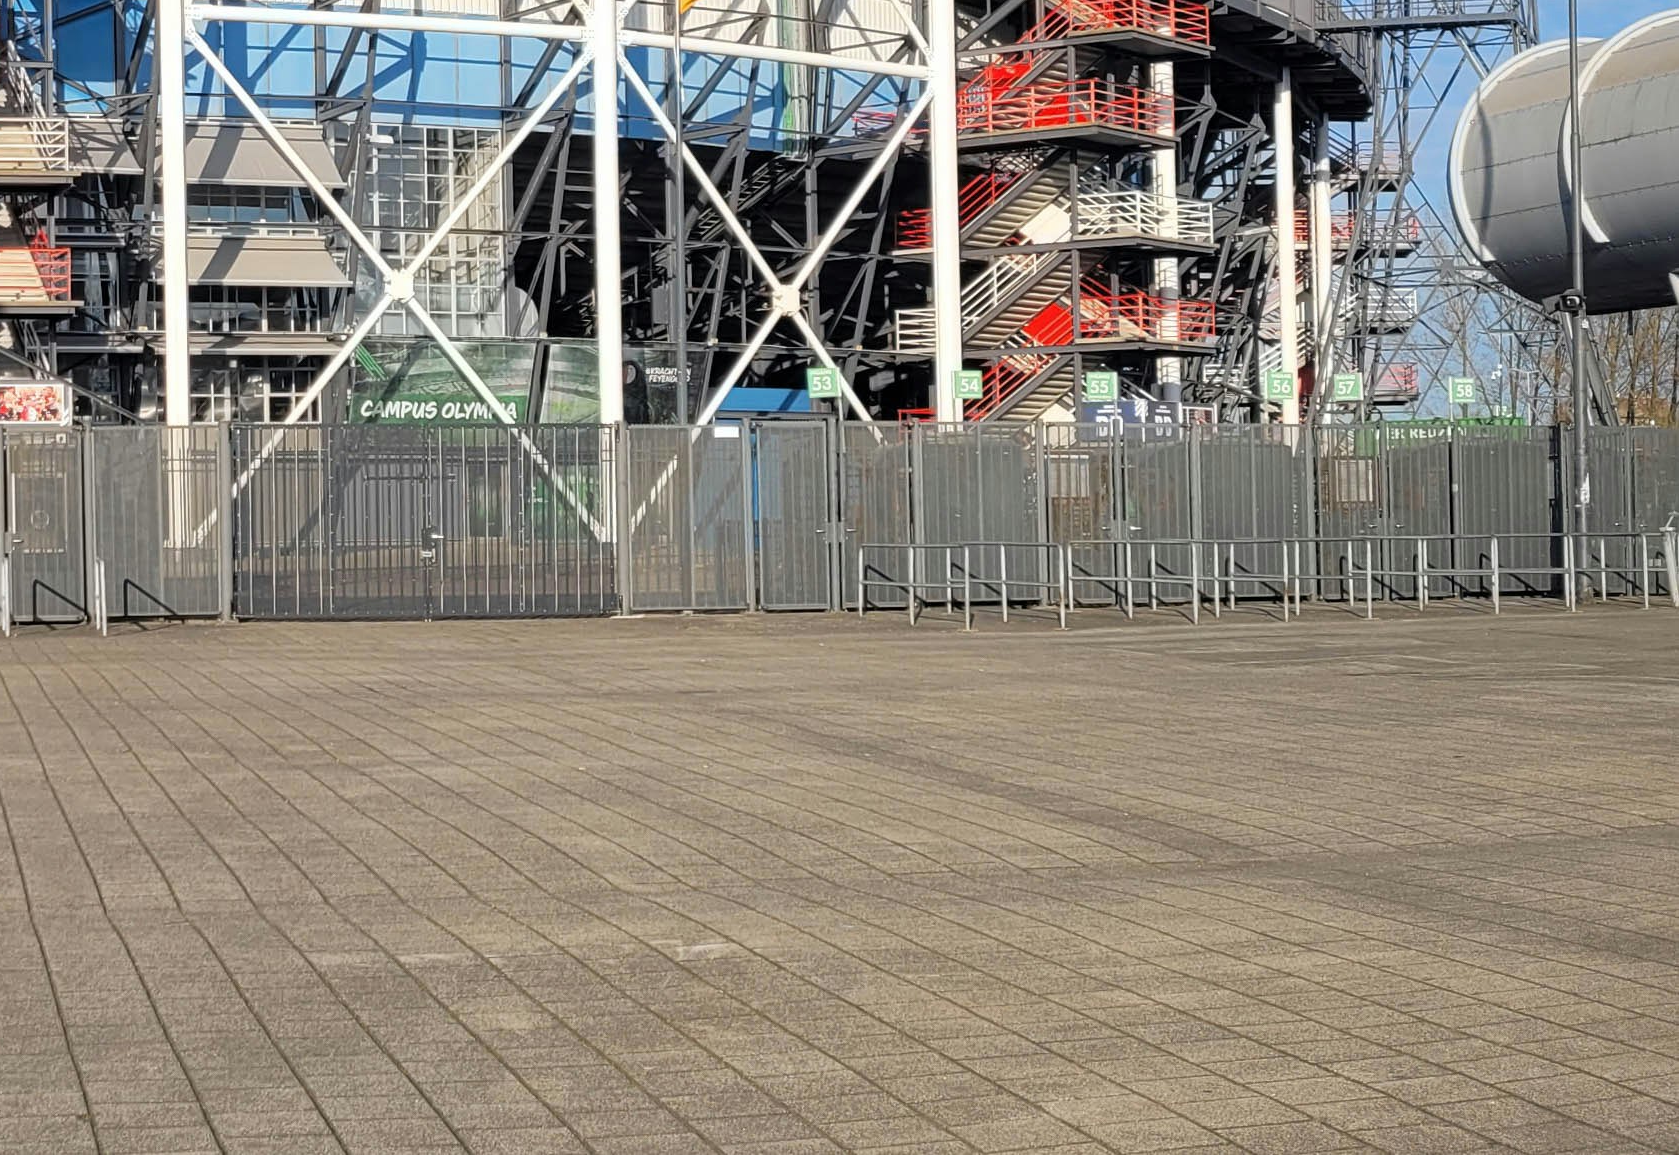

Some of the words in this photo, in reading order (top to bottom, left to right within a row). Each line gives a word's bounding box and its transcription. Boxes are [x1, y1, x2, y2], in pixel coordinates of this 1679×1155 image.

[813, 376, 832, 391] 53
[960, 378, 979, 392] 54
[1090, 380, 1109, 394] 55
[1272, 379, 1291, 393] 56
[1337, 381, 1355, 394] 57
[1456, 384, 1473, 397] 58
[360, 400, 438, 419] CAMPUS
[441, 401, 517, 419] OLYMA
